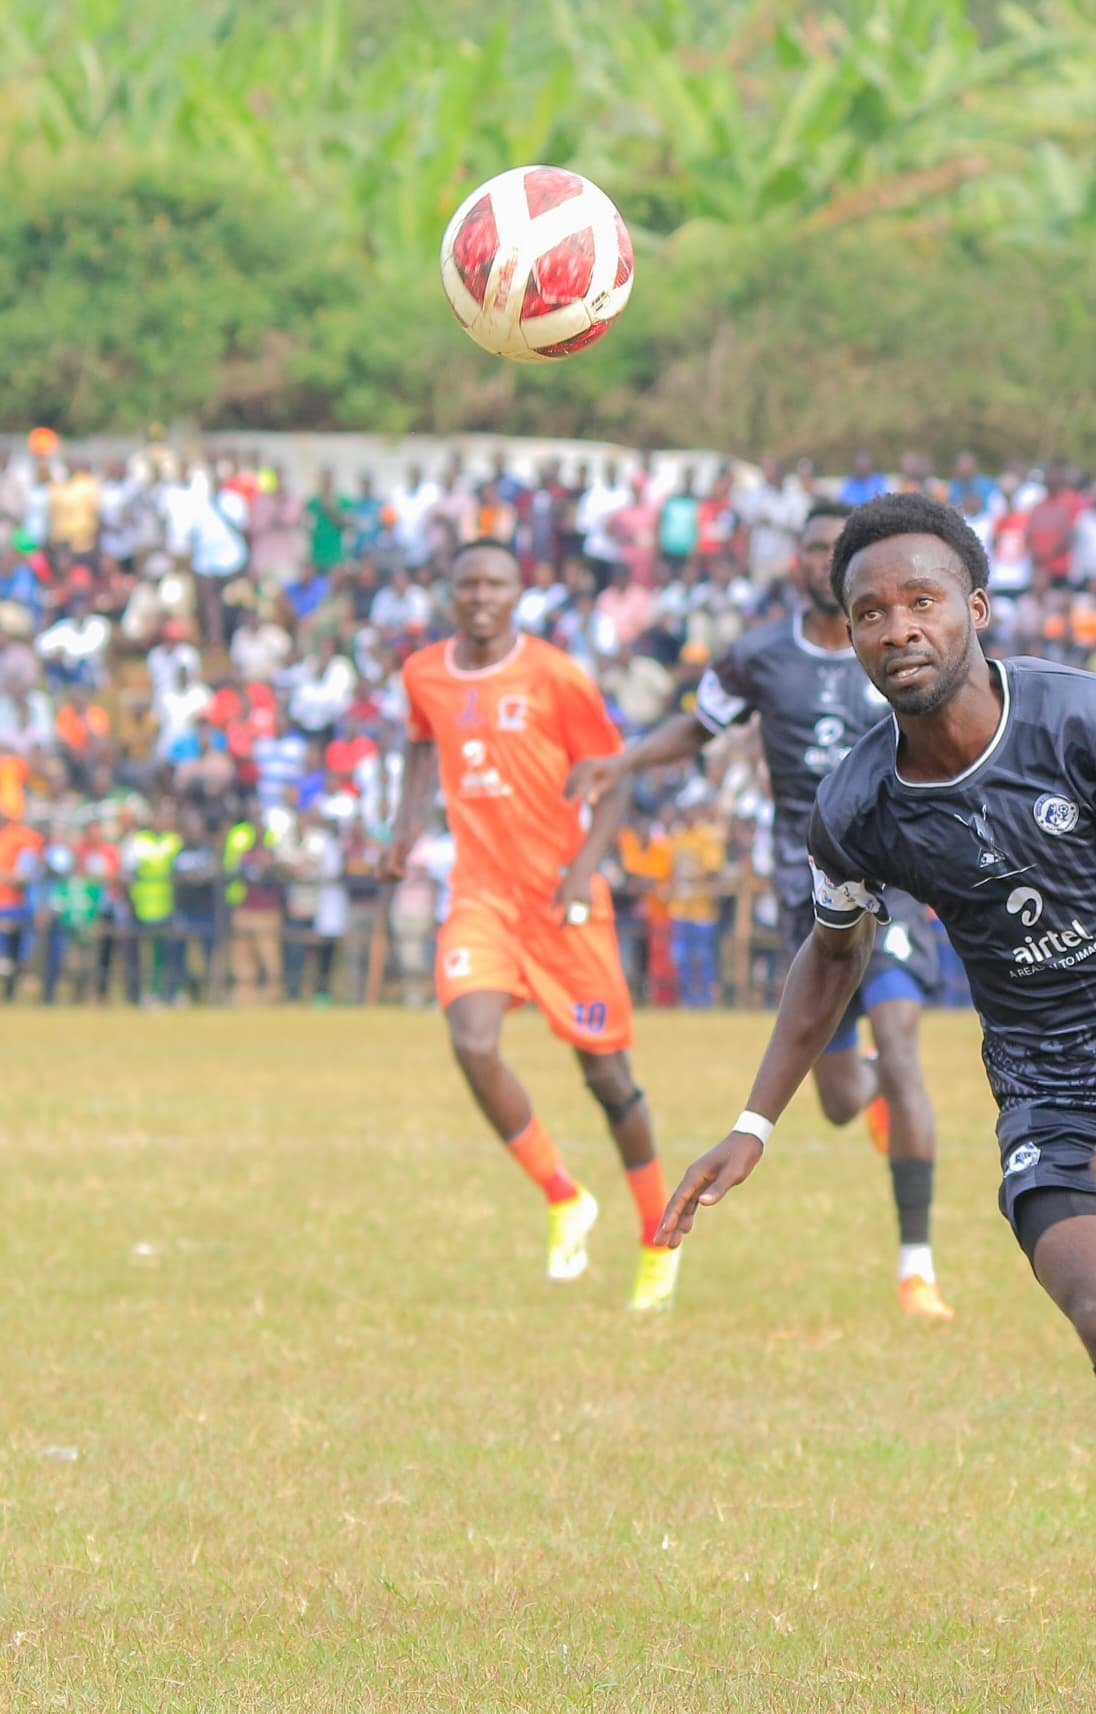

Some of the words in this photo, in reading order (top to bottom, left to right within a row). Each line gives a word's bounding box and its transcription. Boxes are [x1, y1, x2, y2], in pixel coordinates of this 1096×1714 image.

[1012, 919, 1094, 965] airtel
[1058, 956, 1075, 970] TO
[574, 1002, 606, 1033] 10
